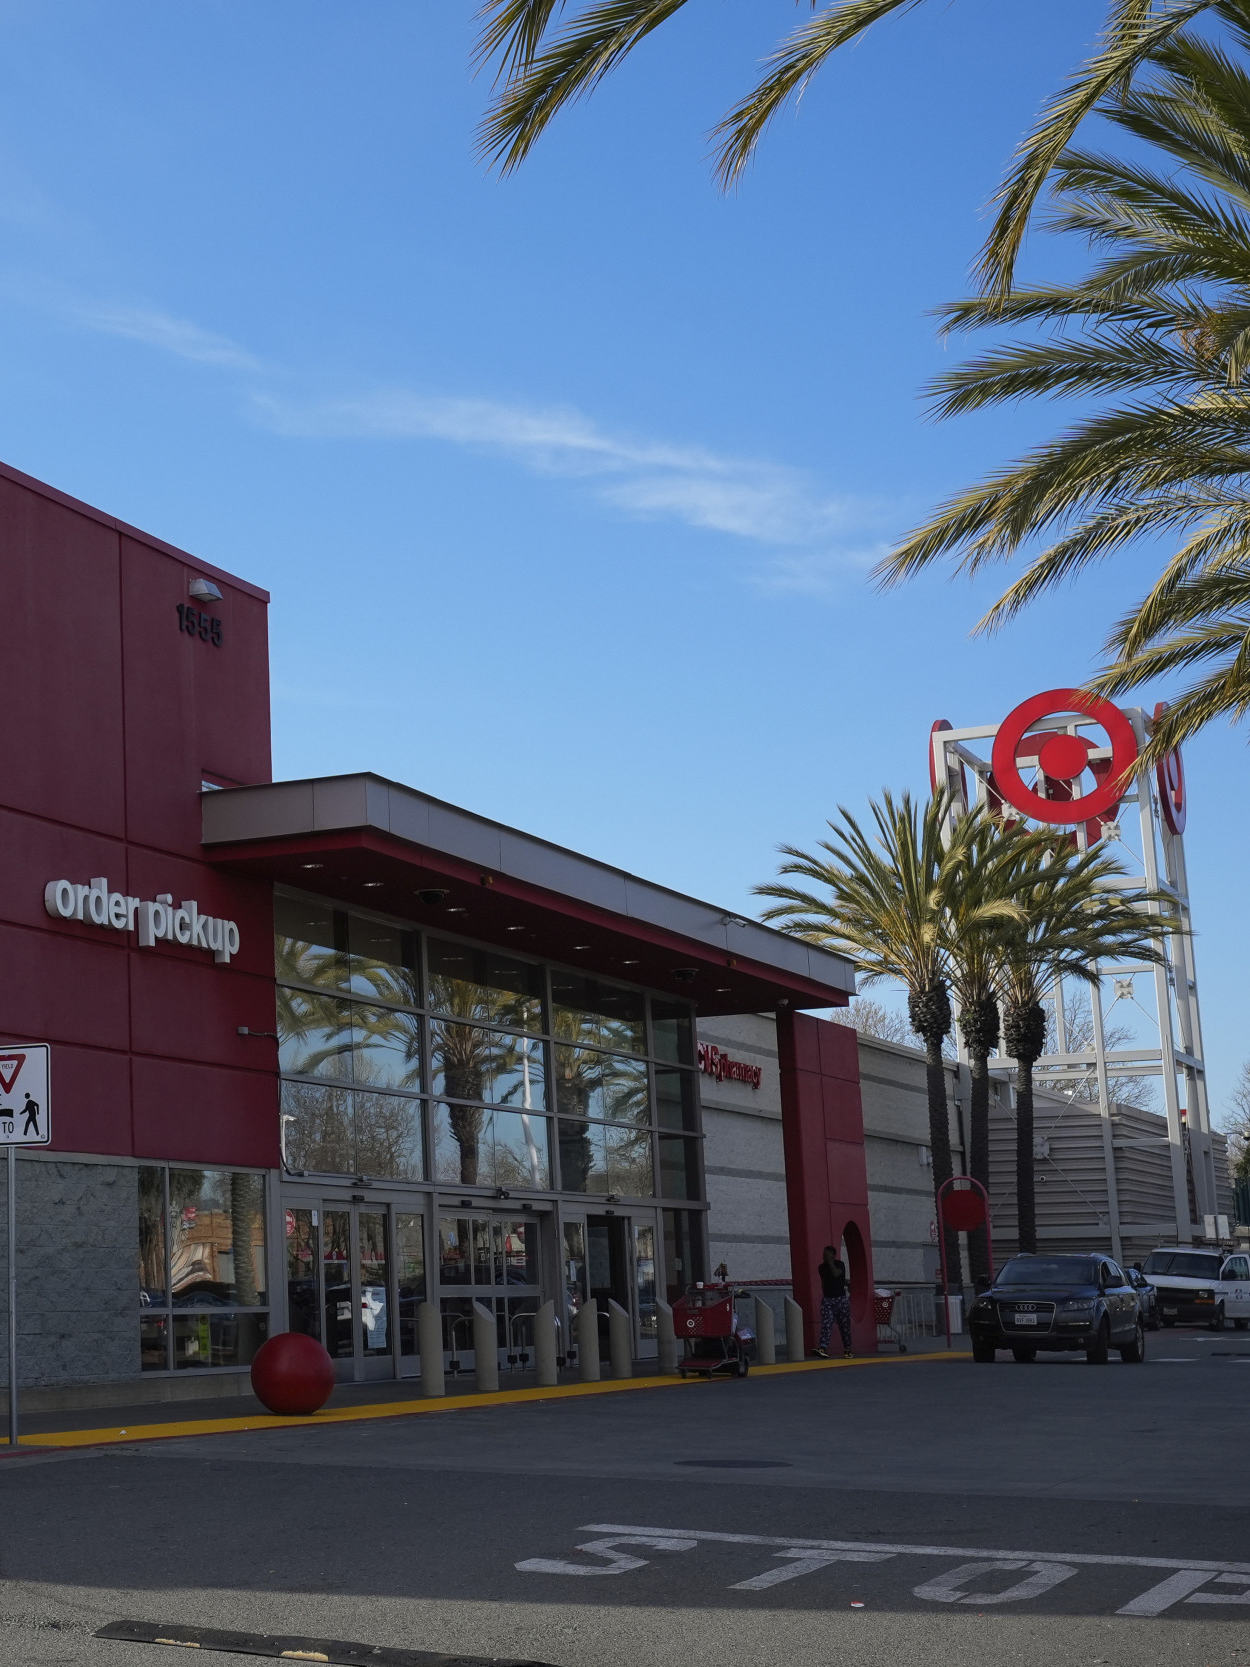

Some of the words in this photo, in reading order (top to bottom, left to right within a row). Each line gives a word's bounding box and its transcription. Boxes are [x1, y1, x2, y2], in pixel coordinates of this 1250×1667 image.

[176, 603, 223, 646] 1555
[45, 877, 140, 931] order
[138, 893, 241, 963] pickup
[716, 1053, 762, 1090] pharmacy
[2, 1121, 14, 1134] TO
[514, 1535, 1250, 1617] STOP
